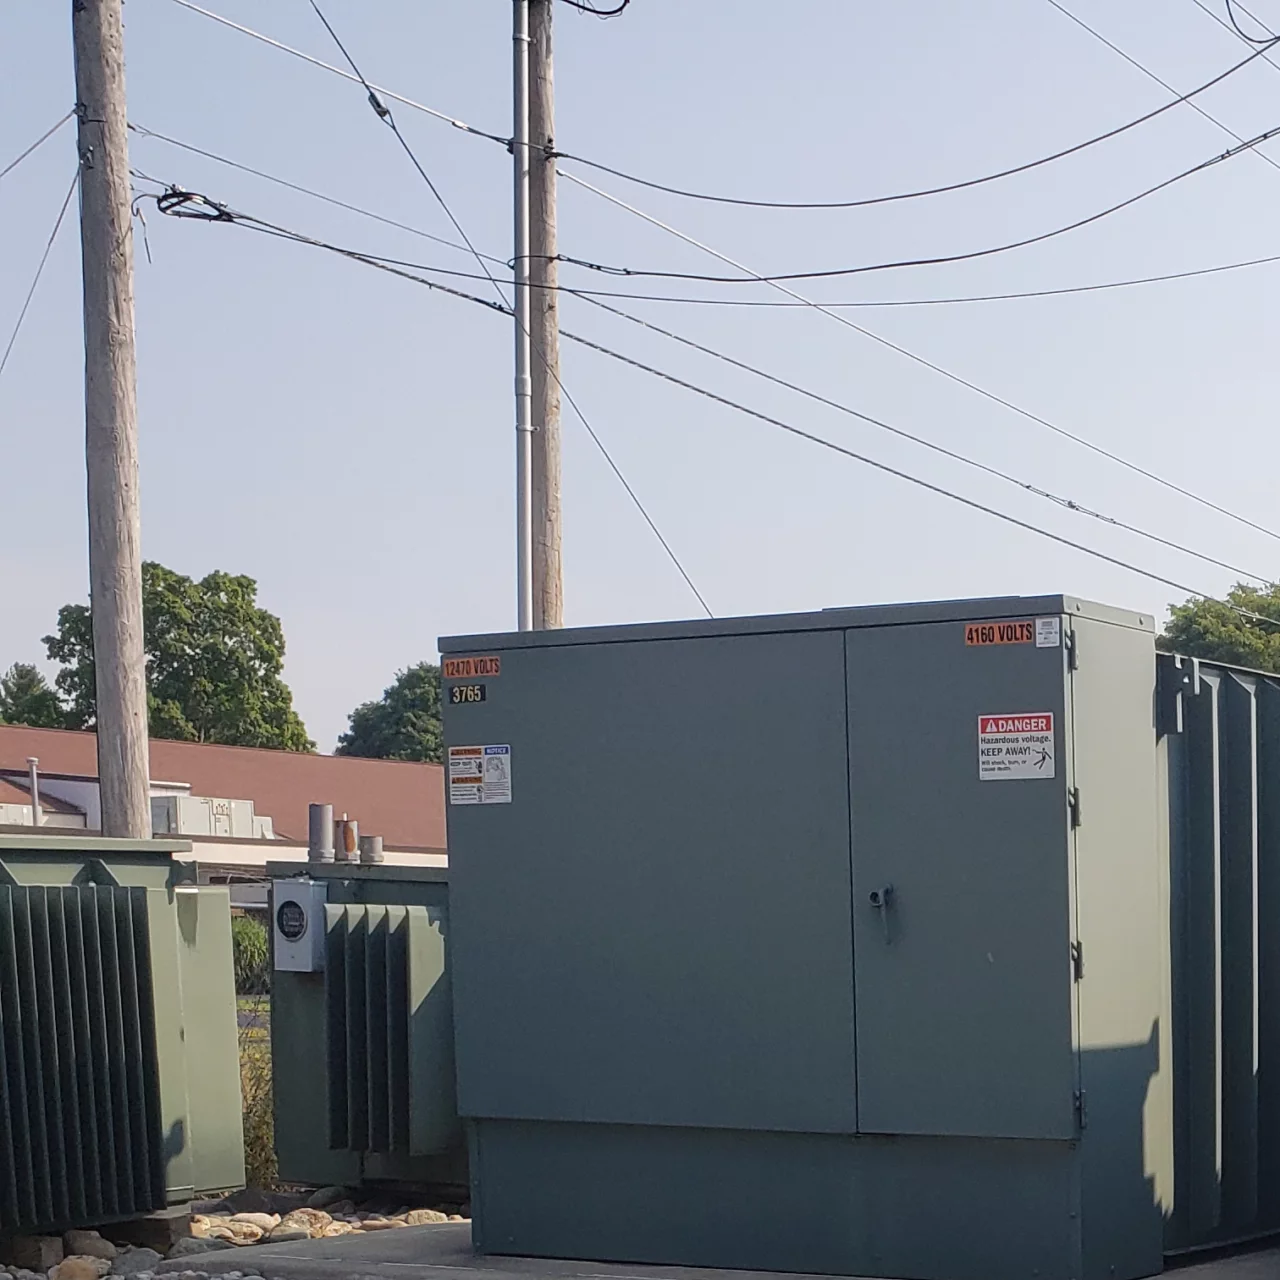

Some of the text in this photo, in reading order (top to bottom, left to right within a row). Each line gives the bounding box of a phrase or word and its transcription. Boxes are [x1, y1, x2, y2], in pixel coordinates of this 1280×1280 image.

[967, 626, 995, 644] 4160
[997, 623, 1033, 642] VOLTS
[444, 657, 500, 677] 12470 VOLTS
[452, 685, 482, 703] 3765
[998, 718, 1047, 732] DANGER
[980, 736, 1020, 745] Hazardous
[980, 746, 1031, 757] KEEP AWAY!
